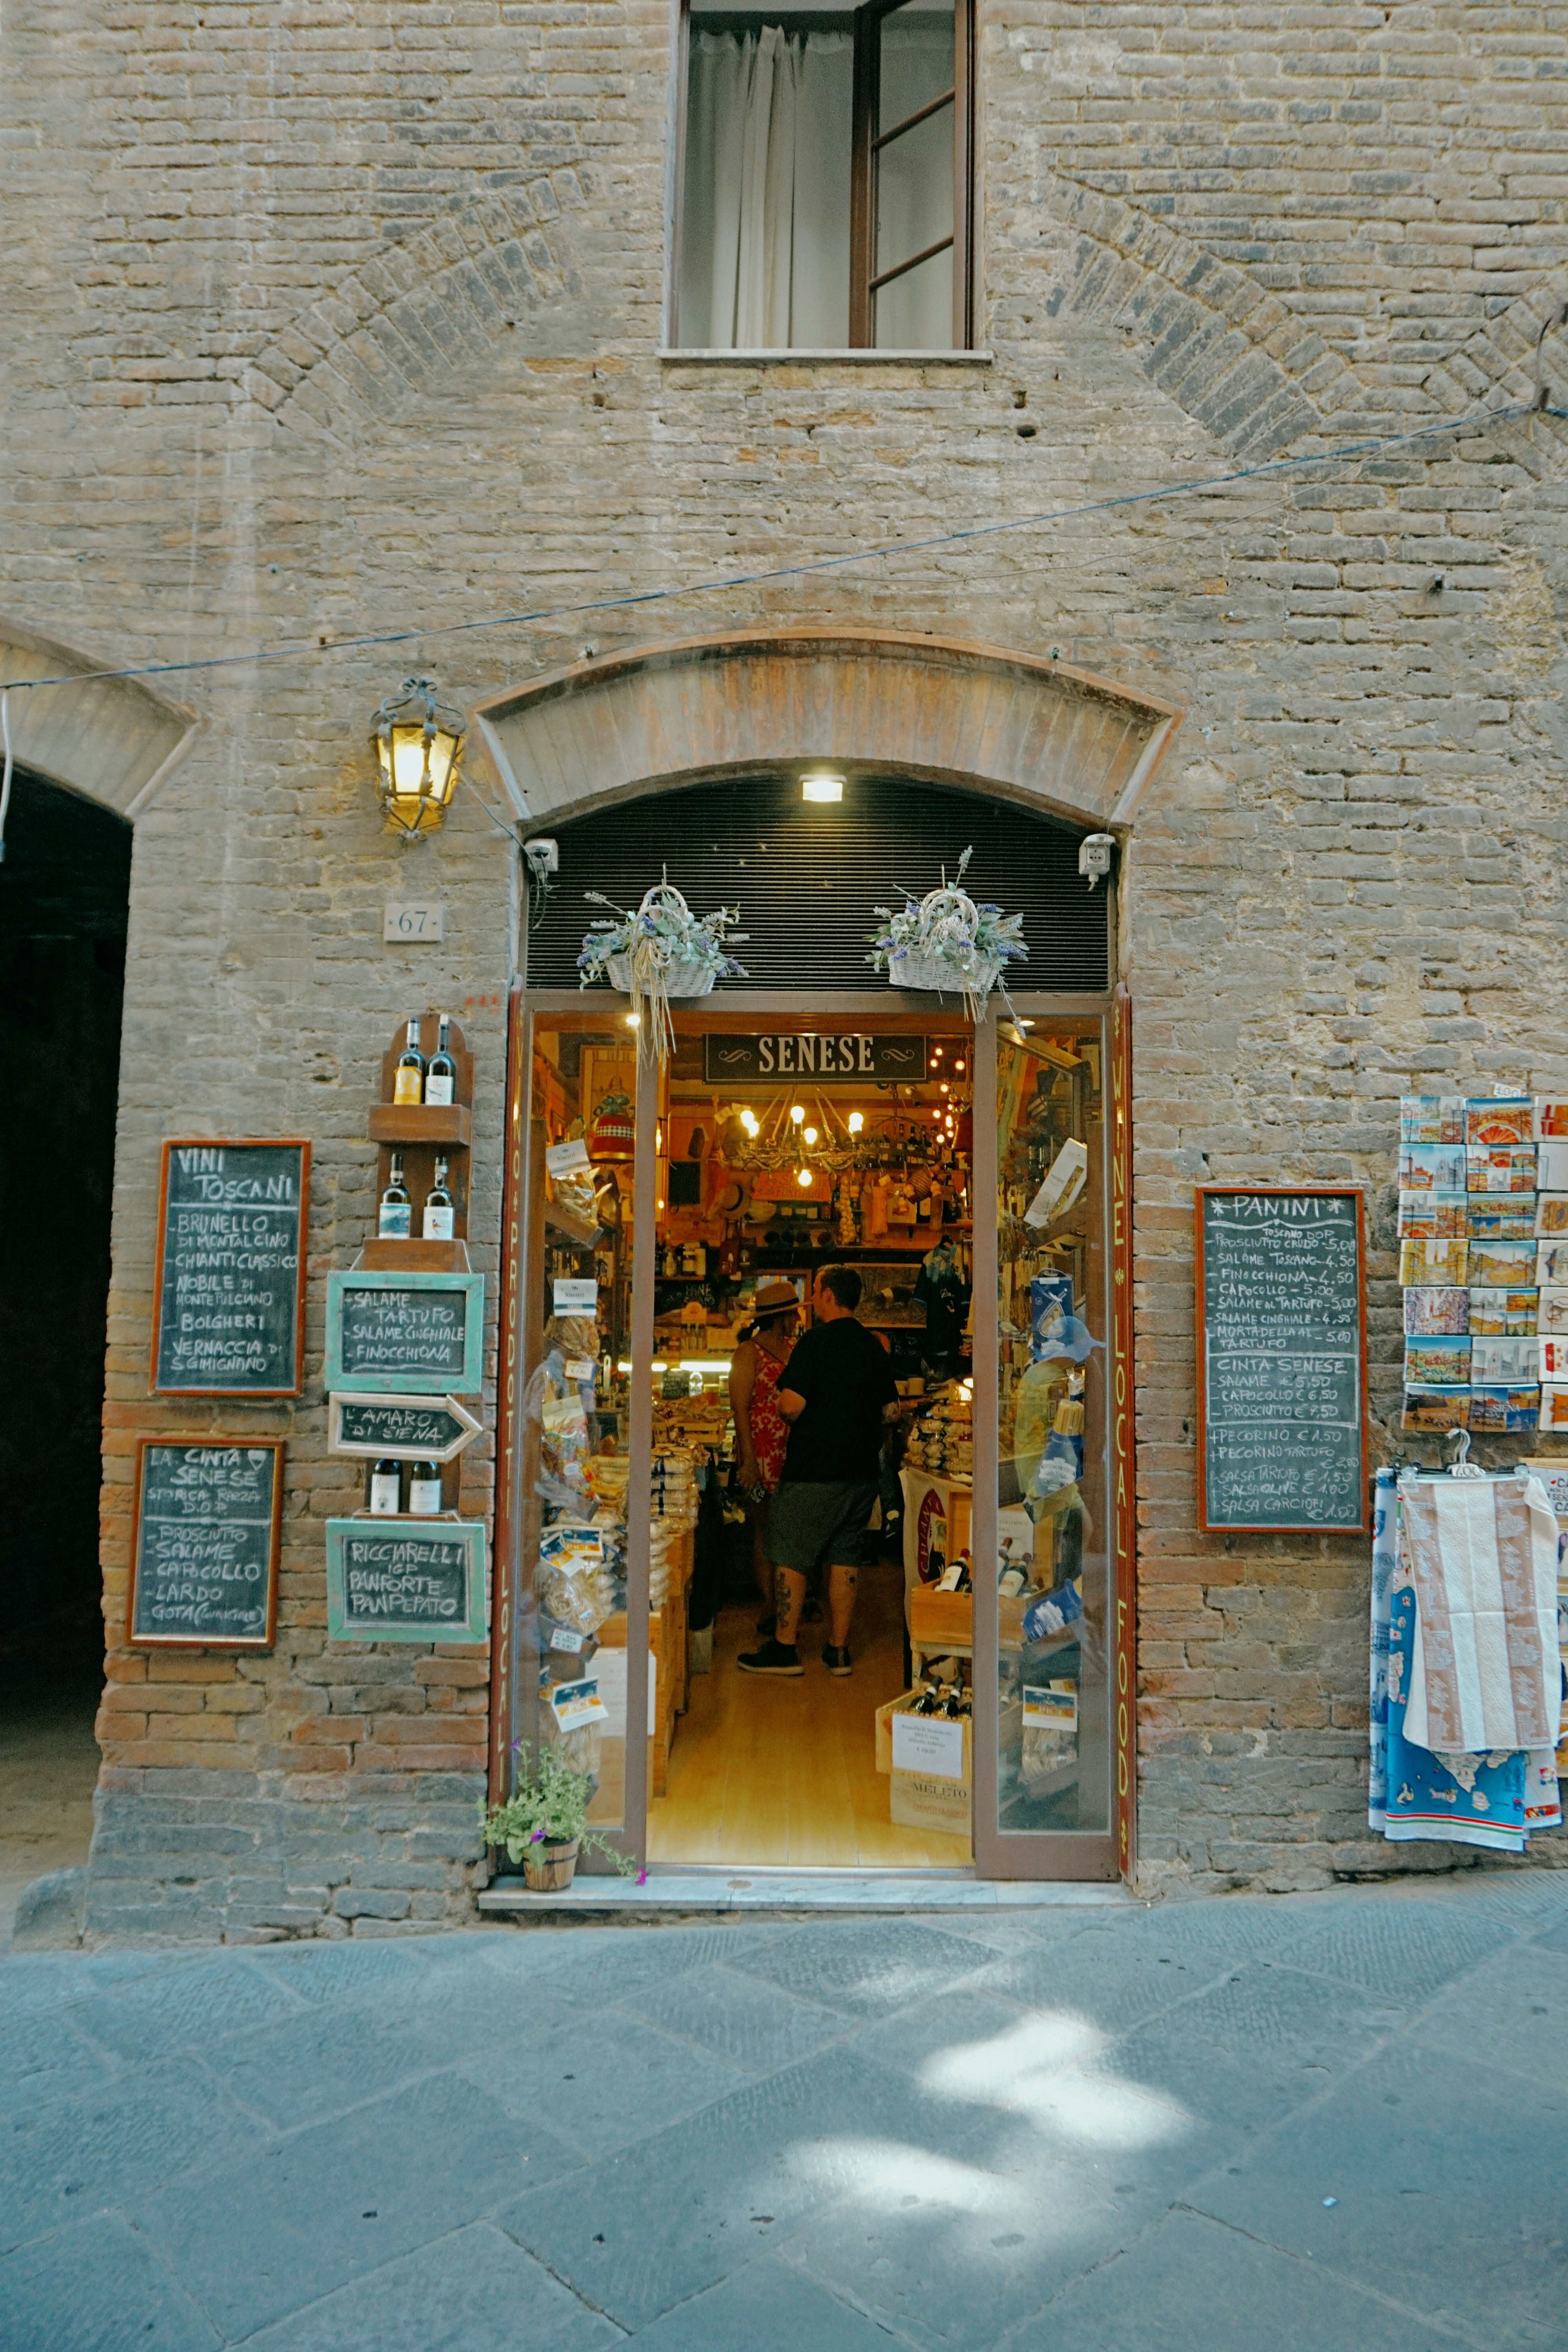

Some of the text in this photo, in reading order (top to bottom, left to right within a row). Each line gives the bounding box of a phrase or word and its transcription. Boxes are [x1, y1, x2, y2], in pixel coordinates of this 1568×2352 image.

[399, 911, 427, 933] 67
[759, 1036, 875, 1072] SENESE
[178, 1148, 224, 1172] VINI
[193, 1175, 292, 1200] TOSCANI
[1233, 1195, 1319, 1218] PANINI
[178, 1214, 268, 1235] BRUNELLO
[178, 1232, 290, 1248] DI MONTALCINO
[1216, 1233, 1281, 1249] PROSCIUTTO
[1284, 1238, 1318, 1249] CRUDO
[1262, 1228, 1334, 1240] TOSCANO DOP
[175, 1253, 298, 1270] CHIANTI CLASSICO
[1217, 1254, 1265, 1265] SALAME
[176, 1275, 253, 1292] NOBILE DI
[1221, 1269, 1309, 1283] FINOCCHIONA
[1219, 1283, 1287, 1296] CAPOCOLLO
[176, 1292, 272, 1307] MONTEPULCIANO
[352, 1292, 410, 1308] SALAME
[1217, 1297, 1263, 1309] SALAME
[1276, 1296, 1323, 1310] TARTUFO
[181, 1314, 264, 1331] BOLGHERI
[376, 1308, 455, 1324] TARTUFO
[1215, 1313, 1258, 1323] SALAME
[1260, 1314, 1312, 1325] CINGHIALE
[352, 1325, 465, 1342] SALAME CINGHIALE
[1217, 1325, 1297, 1337] MORTADELLA
[172, 1337, 261, 1356] VERNACCIA
[1220, 1338, 1286, 1349] TARTUFO
[357, 1345, 452, 1362] FINOCCHIONA
[505, 1221, 517, 1518] PRODOTTI
[1217, 1358, 1348, 1374] CINTA SENESE
[1217, 1375, 1271, 1388] SALAME
[1222, 1390, 1293, 1401] CAPOCOLLO
[1222, 1405, 1292, 1417] PROSCIUTTO
[352, 1424, 443, 1441] DI SIENA
[1113, 1055, 1128, 1797] WINE LOCAL FOOD
[151, 1448, 241, 1467] LA CINTA
[1284, 1447, 1335, 1457] TARTUFO
[170, 1465, 258, 1487] SENESE
[1217, 1470, 1255, 1484] SALSA
[1253, 1464, 1300, 1481] TARTUFO
[147, 1488, 260, 1502] STORICA RAZZA
[1221, 1497, 1324, 1514] SALSA CARCIOFI
[160, 1525, 247, 1543] PROSCIUTTO
[155, 1541, 235, 1559] SALAME
[352, 1541, 462, 1566] RICCIARELLI
[157, 1562, 260, 1581] CAPOCOLLO
[388, 1563, 418, 1574] IGP
[349, 1571, 443, 1595] PANFORTE
[155, 1584, 222, 1602] LARDO
[350, 1594, 458, 1616] PANPEPATO
[498, 1565, 508, 1792] LOCALI
[927, 1728, 952, 1736] Montalcino
[913, 1783, 967, 1798] MELETO
